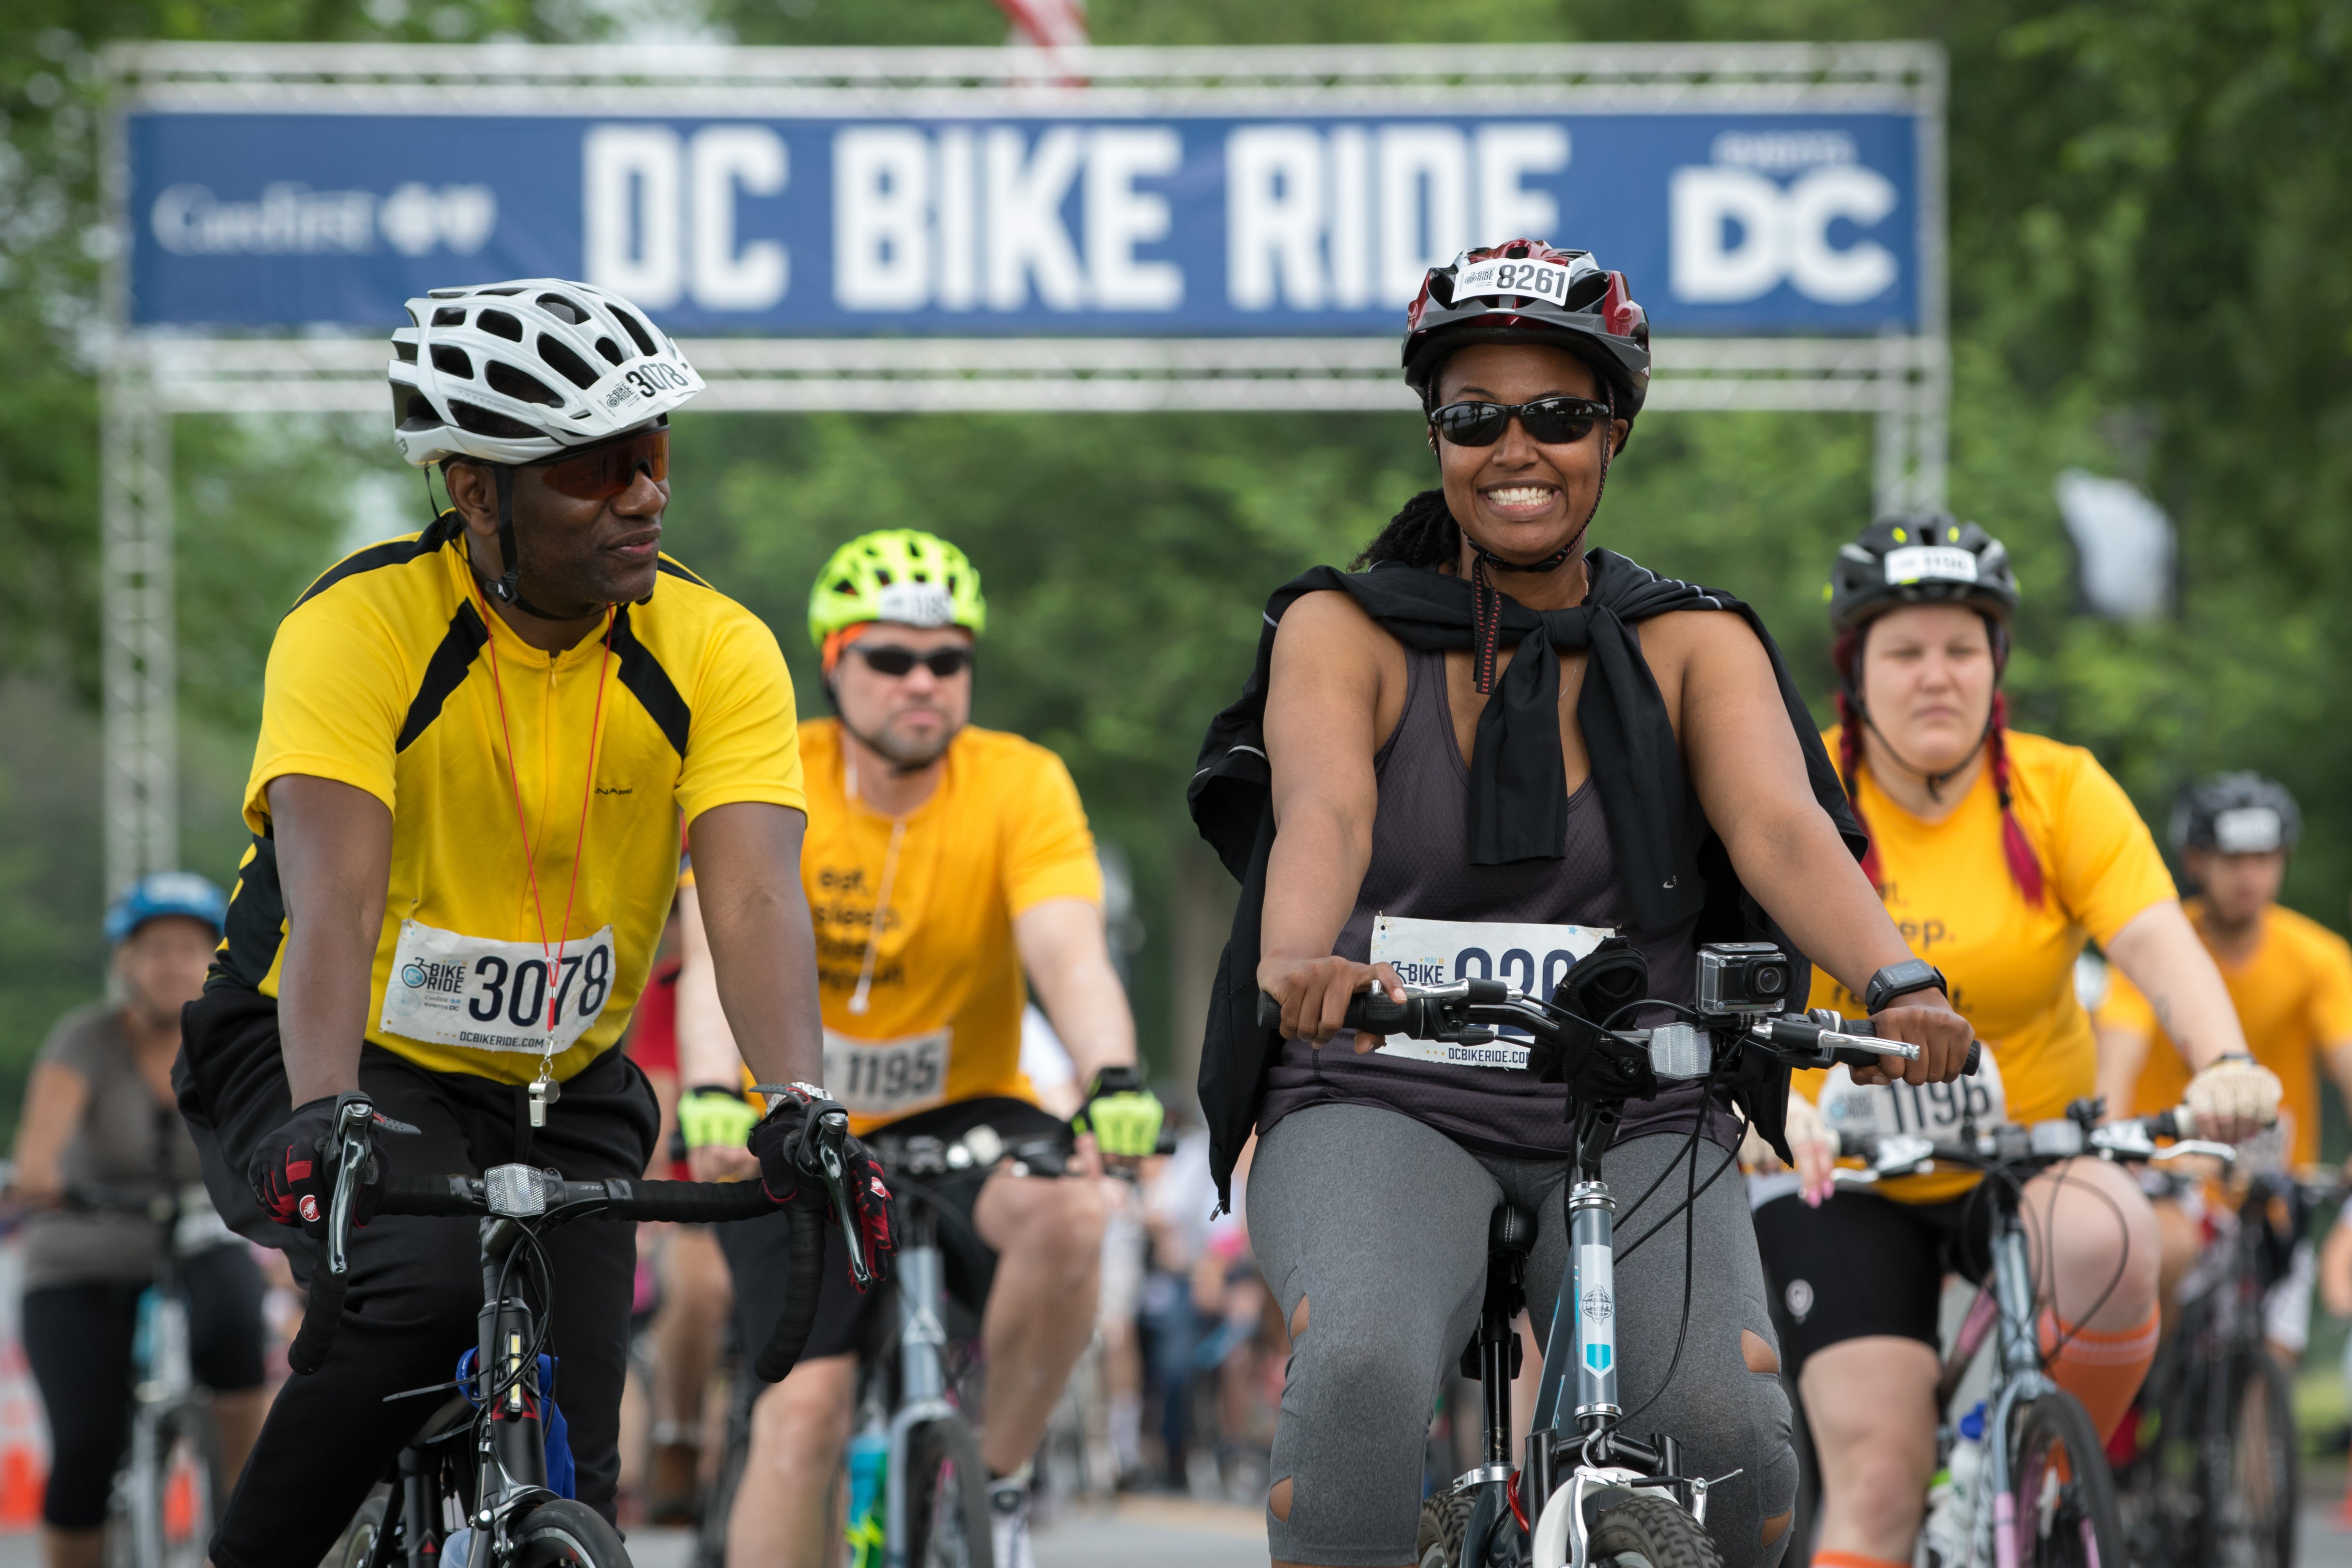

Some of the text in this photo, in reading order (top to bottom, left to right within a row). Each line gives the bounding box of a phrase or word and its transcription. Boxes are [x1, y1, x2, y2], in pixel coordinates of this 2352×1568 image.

[583, 126, 1568, 311] DC BIKE RIDE
[1672, 168, 1897, 304] DC
[1497, 264, 1566, 298] 8261
[626, 363, 688, 397] 3078
[613, 383, 628, 396] BIKE
[618, 386, 634, 402] RIDE
[407, 971, 420, 982] DC
[429, 963, 466, 979] BIKE
[1409, 964, 1444, 984] BIKE
[427, 977, 463, 993] RIDE
[469, 945, 608, 1027] 3078
[460, 1031, 544, 1048] DCBIKERIDE.COM
[1449, 1048, 1529, 1064] DCBIKERIDE.CO
[847, 1039, 940, 1099] 1195
[1583, 1301, 1612, 1312] HUFFY
